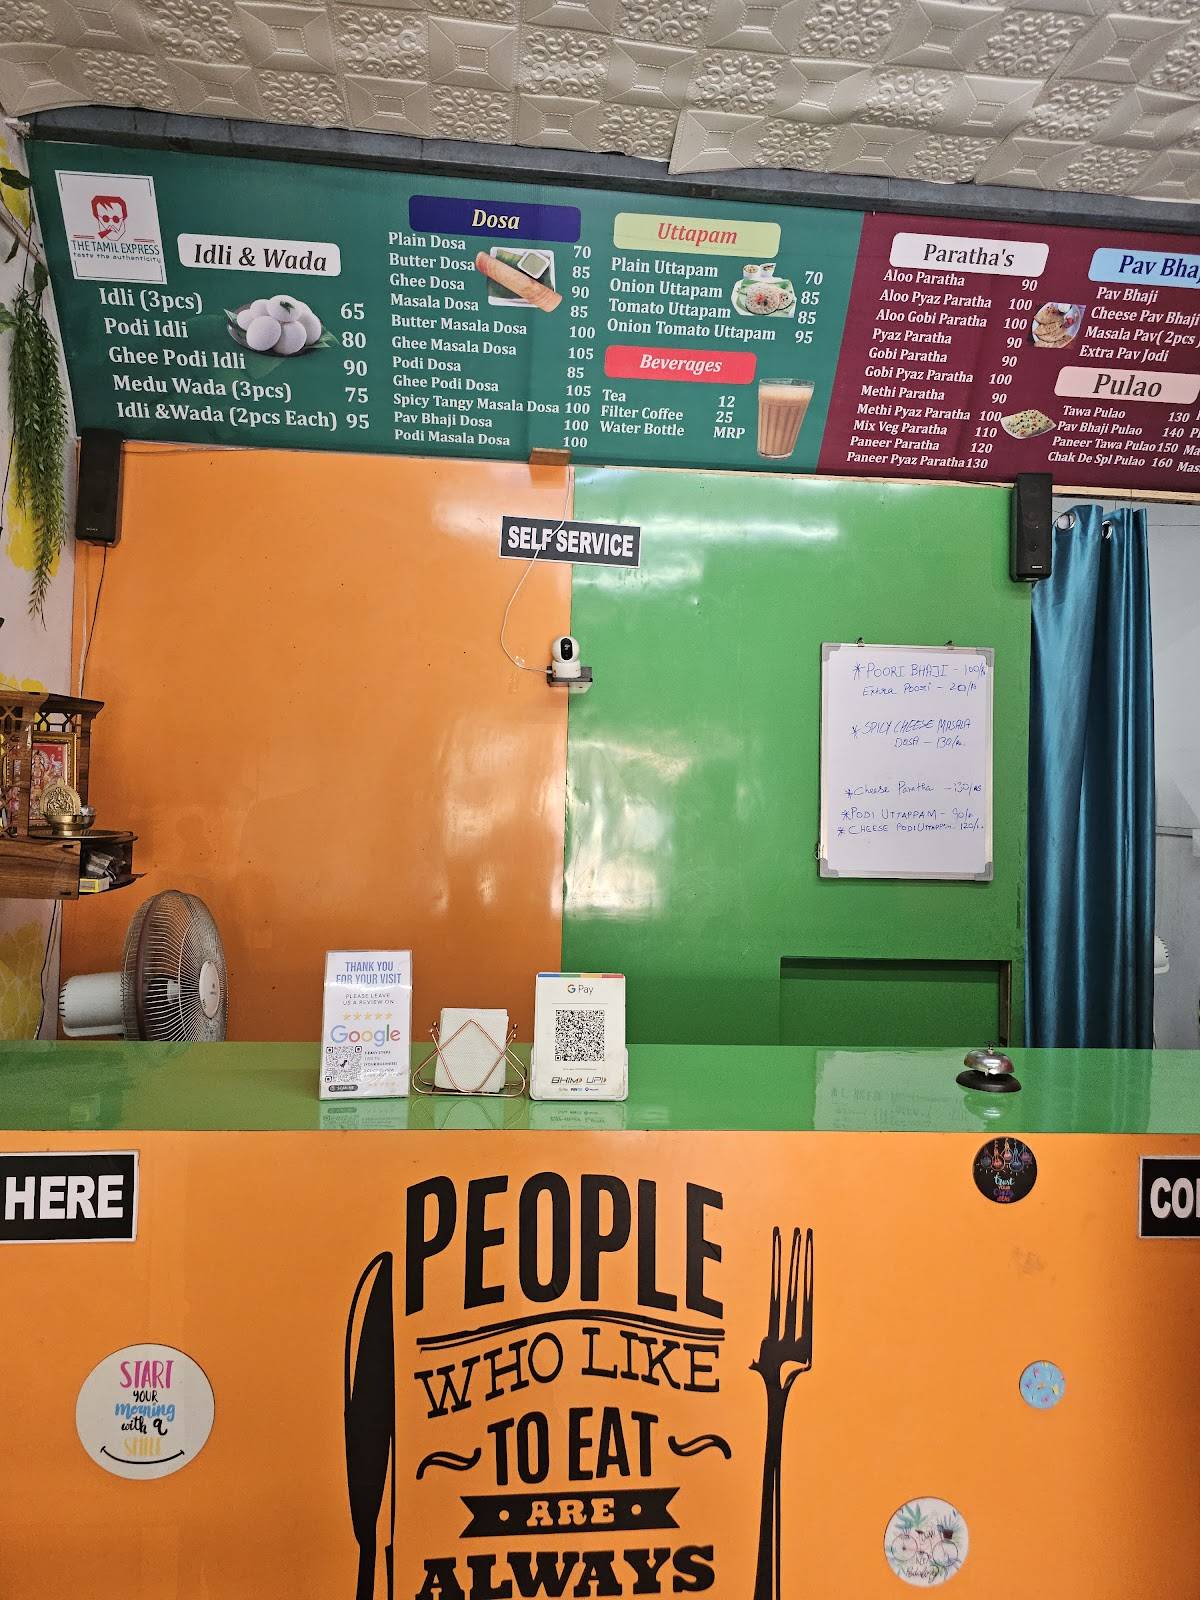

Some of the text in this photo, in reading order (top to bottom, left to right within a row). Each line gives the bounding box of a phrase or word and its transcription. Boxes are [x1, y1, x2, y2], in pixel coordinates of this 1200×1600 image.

[472, 209, 520, 230] Dosa
[389, 232, 591, 258] Plain Dosa 70
[658, 223, 737, 246] Uttapam
[71, 240, 160, 255] THE TAMIL EXPRESS
[113, 255, 161, 263] authenticity
[195, 244, 326, 271] Idli & Wada
[923, 244, 1014, 267] Paratha's
[389, 253, 590, 279] Butter Dosa 85
[611, 257, 823, 285] Plain Uttapam 70
[1119, 255, 1157, 275] Pav
[390, 273, 589, 298] Ghee Dosa 90
[610, 278, 820, 305] Onion Uttapam 85
[883, 269, 1037, 292] Aloo Paratha 90
[99, 288, 364, 319] Idli (3pcs) 65
[879, 289, 1032, 310] Aloo Pyaz Paratha 100
[1096, 287, 1158, 305] Pav Bhaji
[104, 317, 366, 349] Podi Idli 80
[392, 314, 595, 338] Butter Masala Dosa 100
[608, 318, 813, 343] Onion Tomato Uttapam 95
[109, 346, 367, 376] Ghee Podi Idli 90
[640, 354, 722, 375] Beverages
[869, 346, 1017, 367] Gobi Paratha 90
[1079, 345, 1169, 363] Extra Pav Jodi
[113, 375, 368, 403] Medu Wada (3pcs) 75
[1093, 373, 1162, 398] Pulao
[394, 393, 590, 414] Spicy Tangy Masala Dosa 100
[603, 389, 735, 407] Tea 12
[117, 402, 370, 431] Idli &Wada (2pcs Each) 95
[395, 412, 589, 431] Pav Bhaji Dosa 100
[601, 405, 733, 423] Filter Coffee 25
[1064, 405, 1091, 416] Tawa
[1093, 407, 1125, 418] Pulao
[1168, 412, 1190, 422] 130
[600, 421, 745, 439] Water Bottle MRP
[853, 420, 997, 437] Mix Veg Paratha 110
[850, 435, 992, 454] Paneer Paratha 120
[1048, 451, 1173, 467] Chak De Spl Pulao 160
[508, 526, 633, 557] SELF SERVICE
[911, 664, 948, 677] BHAJI
[345, 961, 393, 972] THANK YOU
[336, 973, 401, 984] FOR YOUR VISIT
[568, 984, 592, 995] G Pay
[330, 1024, 400, 1047] Google
[5, 1175, 124, 1220] HERE
[1150, 1177, 1200, 1218] CO
[405, 1171, 723, 1320] PEOPLE
[120, 1360, 174, 1389] START
[413, 1327, 720, 1419] WHO LIKE
[133, 1390, 158, 1402] YOUR
[115, 1402, 175, 1422] morning
[121, 1416, 147, 1434] with
[487, 1406, 659, 1486] TO EAT
[526, 1498, 615, 1528] ARE
[415, 1545, 715, 1600] ALWAYS
